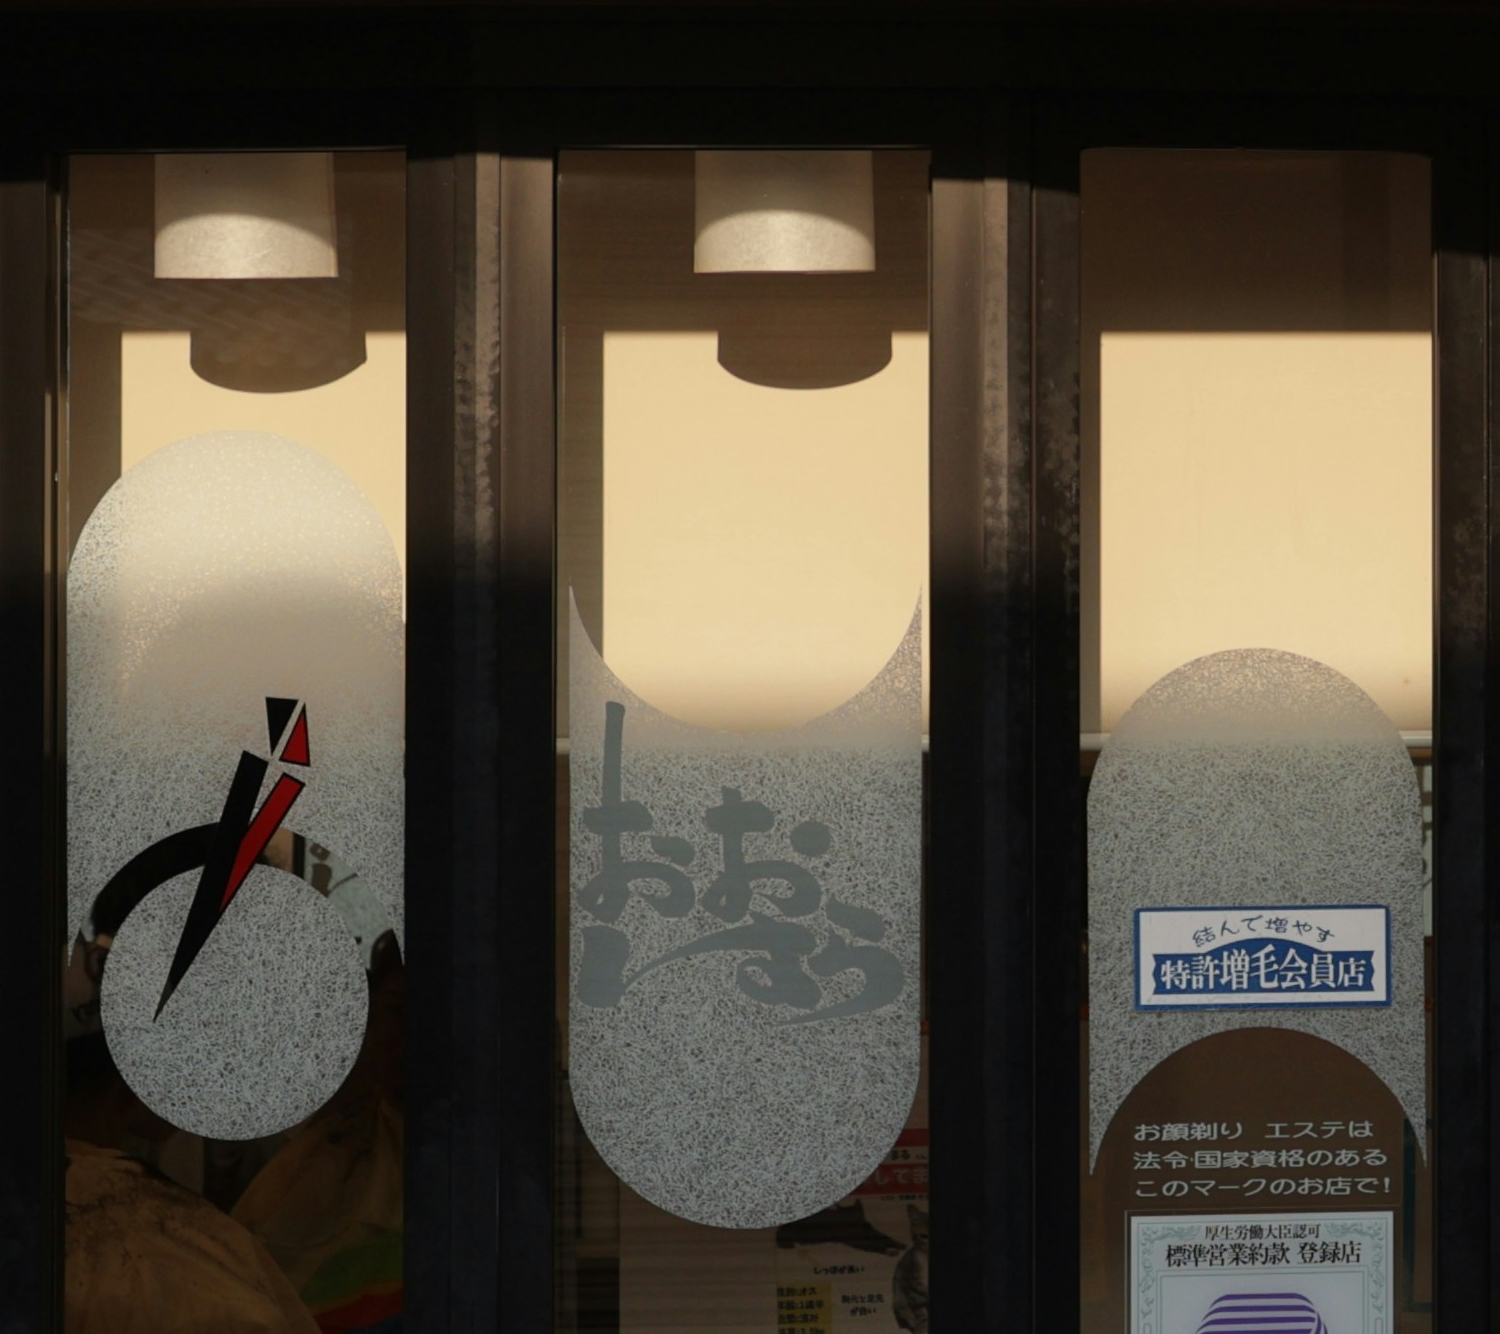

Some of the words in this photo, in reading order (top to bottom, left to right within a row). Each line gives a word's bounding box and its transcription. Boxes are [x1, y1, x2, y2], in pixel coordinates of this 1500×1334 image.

[1191, 913, 1336, 948] 結んで増やす
[1160, 942, 1367, 992] 特許増毛会員店
[1132, 1122, 1245, 1142] お顔剃り
[1263, 1118, 1375, 1140] エステは
[1133, 1174, 1392, 1198] このマークのお店で!
[1204, 1223, 1322, 1242] 厚生労働大臣認可
[1165, 1242, 1291, 1268] 標準営業約款
[1296, 1240, 1362, 1266] 登録店
